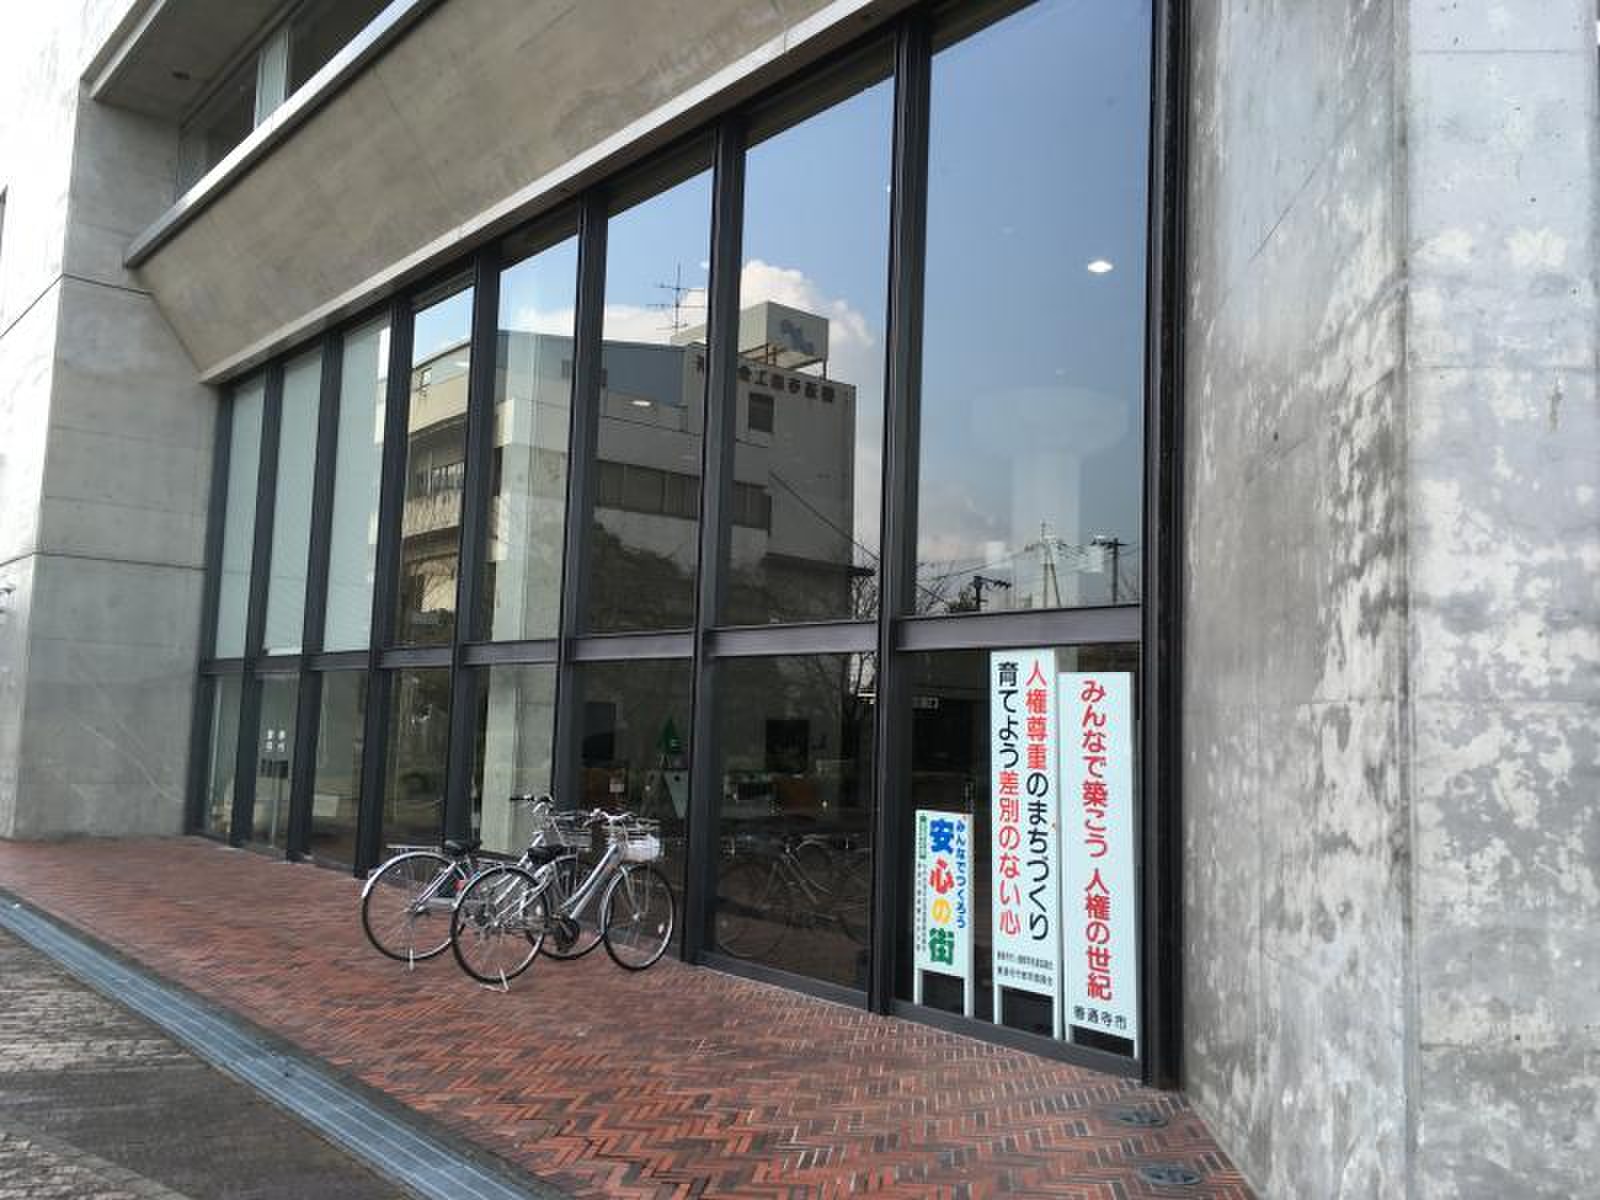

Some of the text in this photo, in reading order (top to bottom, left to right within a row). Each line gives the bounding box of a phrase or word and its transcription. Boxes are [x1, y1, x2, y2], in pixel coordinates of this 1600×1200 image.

[929, 818, 955, 965] 安心の街
[956, 820, 967, 929] みんなでつくろう
[998, 661, 1021, 936] 育てよう差別のない心
[1025, 660, 1050, 941] 人権尊重のまちづくり
[1080, 680, 1112, 1001] みんなで築こう 人権の世紀
